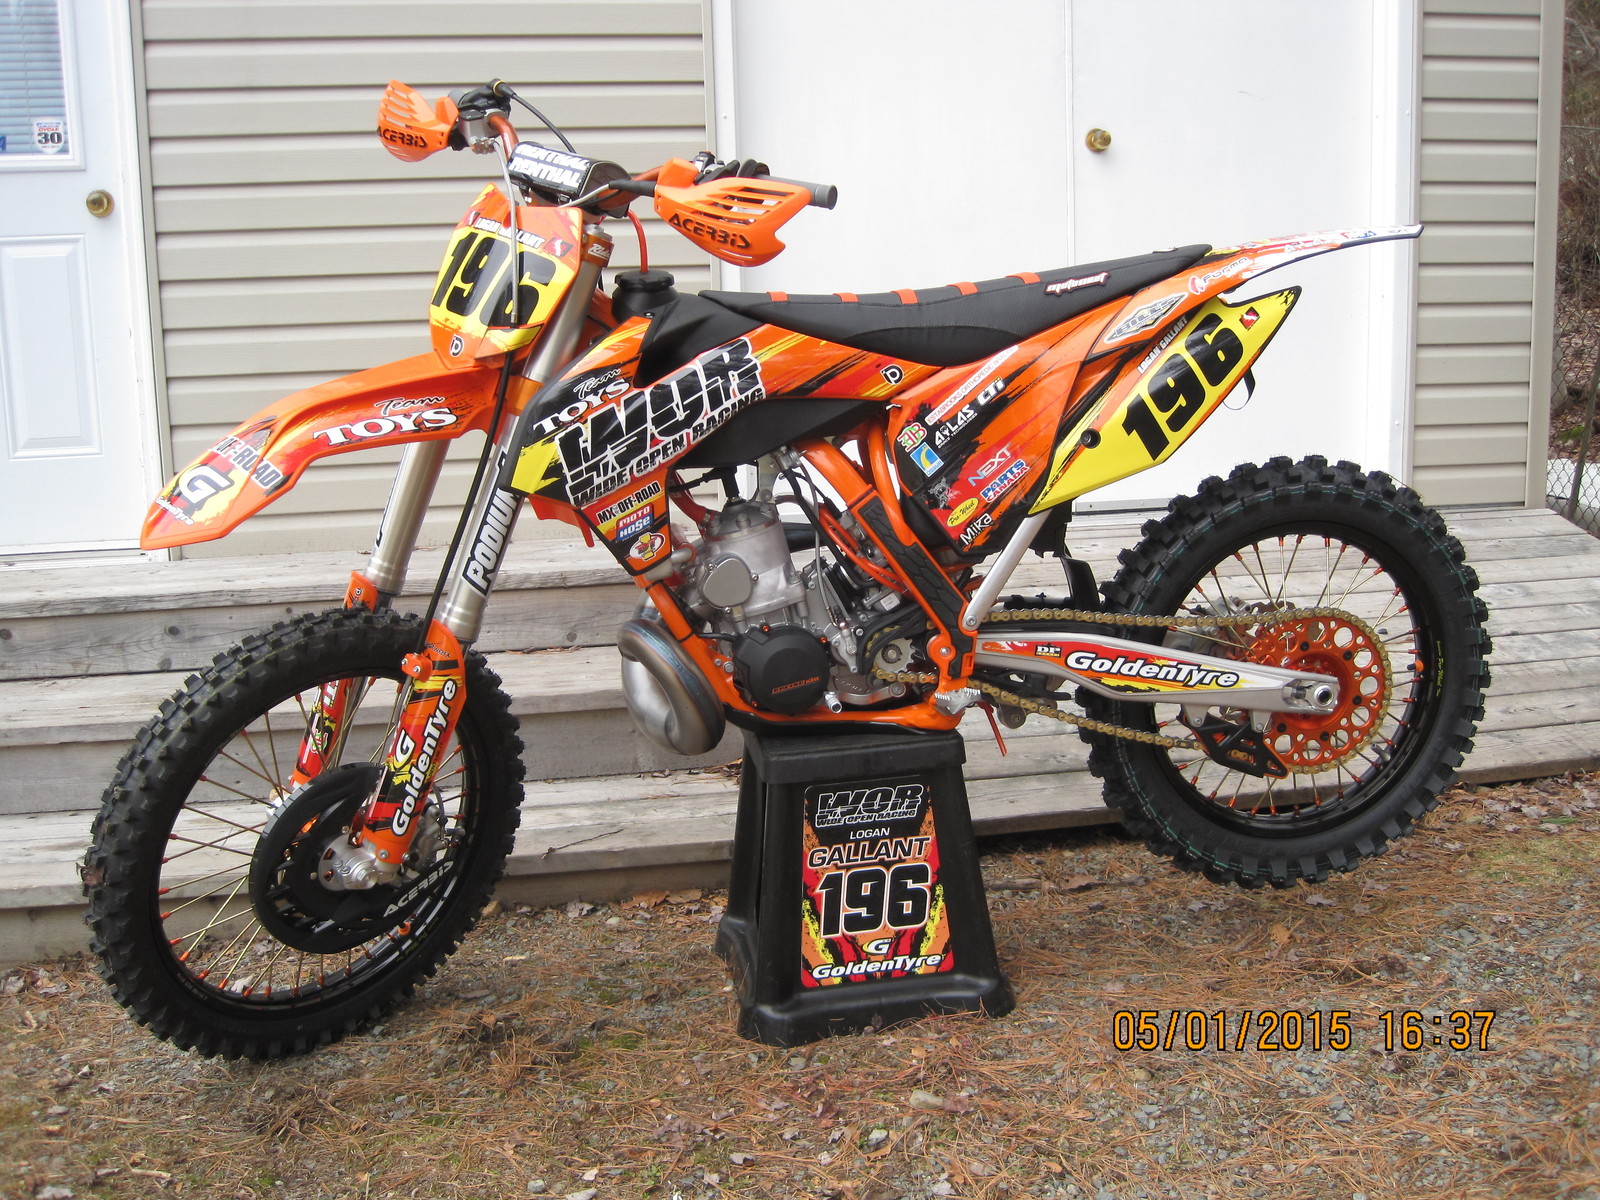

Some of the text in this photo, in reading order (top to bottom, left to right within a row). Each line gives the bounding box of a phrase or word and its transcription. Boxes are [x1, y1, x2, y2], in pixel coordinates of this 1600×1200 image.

[37, 132, 62, 145] 30
[376, 125, 428, 149] ACERBIS
[507, 156, 582, 188] RENTHAL
[514, 143, 590, 171] RENTHAL
[668, 212, 752, 250] ACERBIS
[431, 231, 557, 333] 196
[1136, 346, 1161, 375] LOGAN
[1159, 315, 1189, 350] GALLANT
[573, 368, 622, 399] Team
[1121, 313, 1244, 462] 196
[374, 394, 446, 416] Team
[533, 378, 630, 436] TOYS
[312, 408, 459, 446] TOYS
[573, 387, 767, 506] WIDE OPEN RACING
[967, 442, 1012, 487] NEXT
[980, 459, 1026, 498] PARTS
[986, 467, 1029, 502] CANADA
[597, 481, 662, 524] MX OFF-ROAD
[618, 505, 651, 528] MOTO
[960, 513, 993, 545] Mika
[1065, 651, 1240, 688] GoldenTyre
[391, 678, 458, 837] GoldenTyre
[393, 730, 417, 771] G
[816, 808, 917, 827] WIDE OPEN RACING
[818, 784, 923, 819] WOR
[849, 827, 890, 840] LOGAN
[808, 836, 932, 868] GALLANT
[382, 860, 454, 918] ACERBIS
[816, 863, 932, 939] 196
[863, 938, 893, 955] G
[812, 954, 945, 980] GoldenTyre
